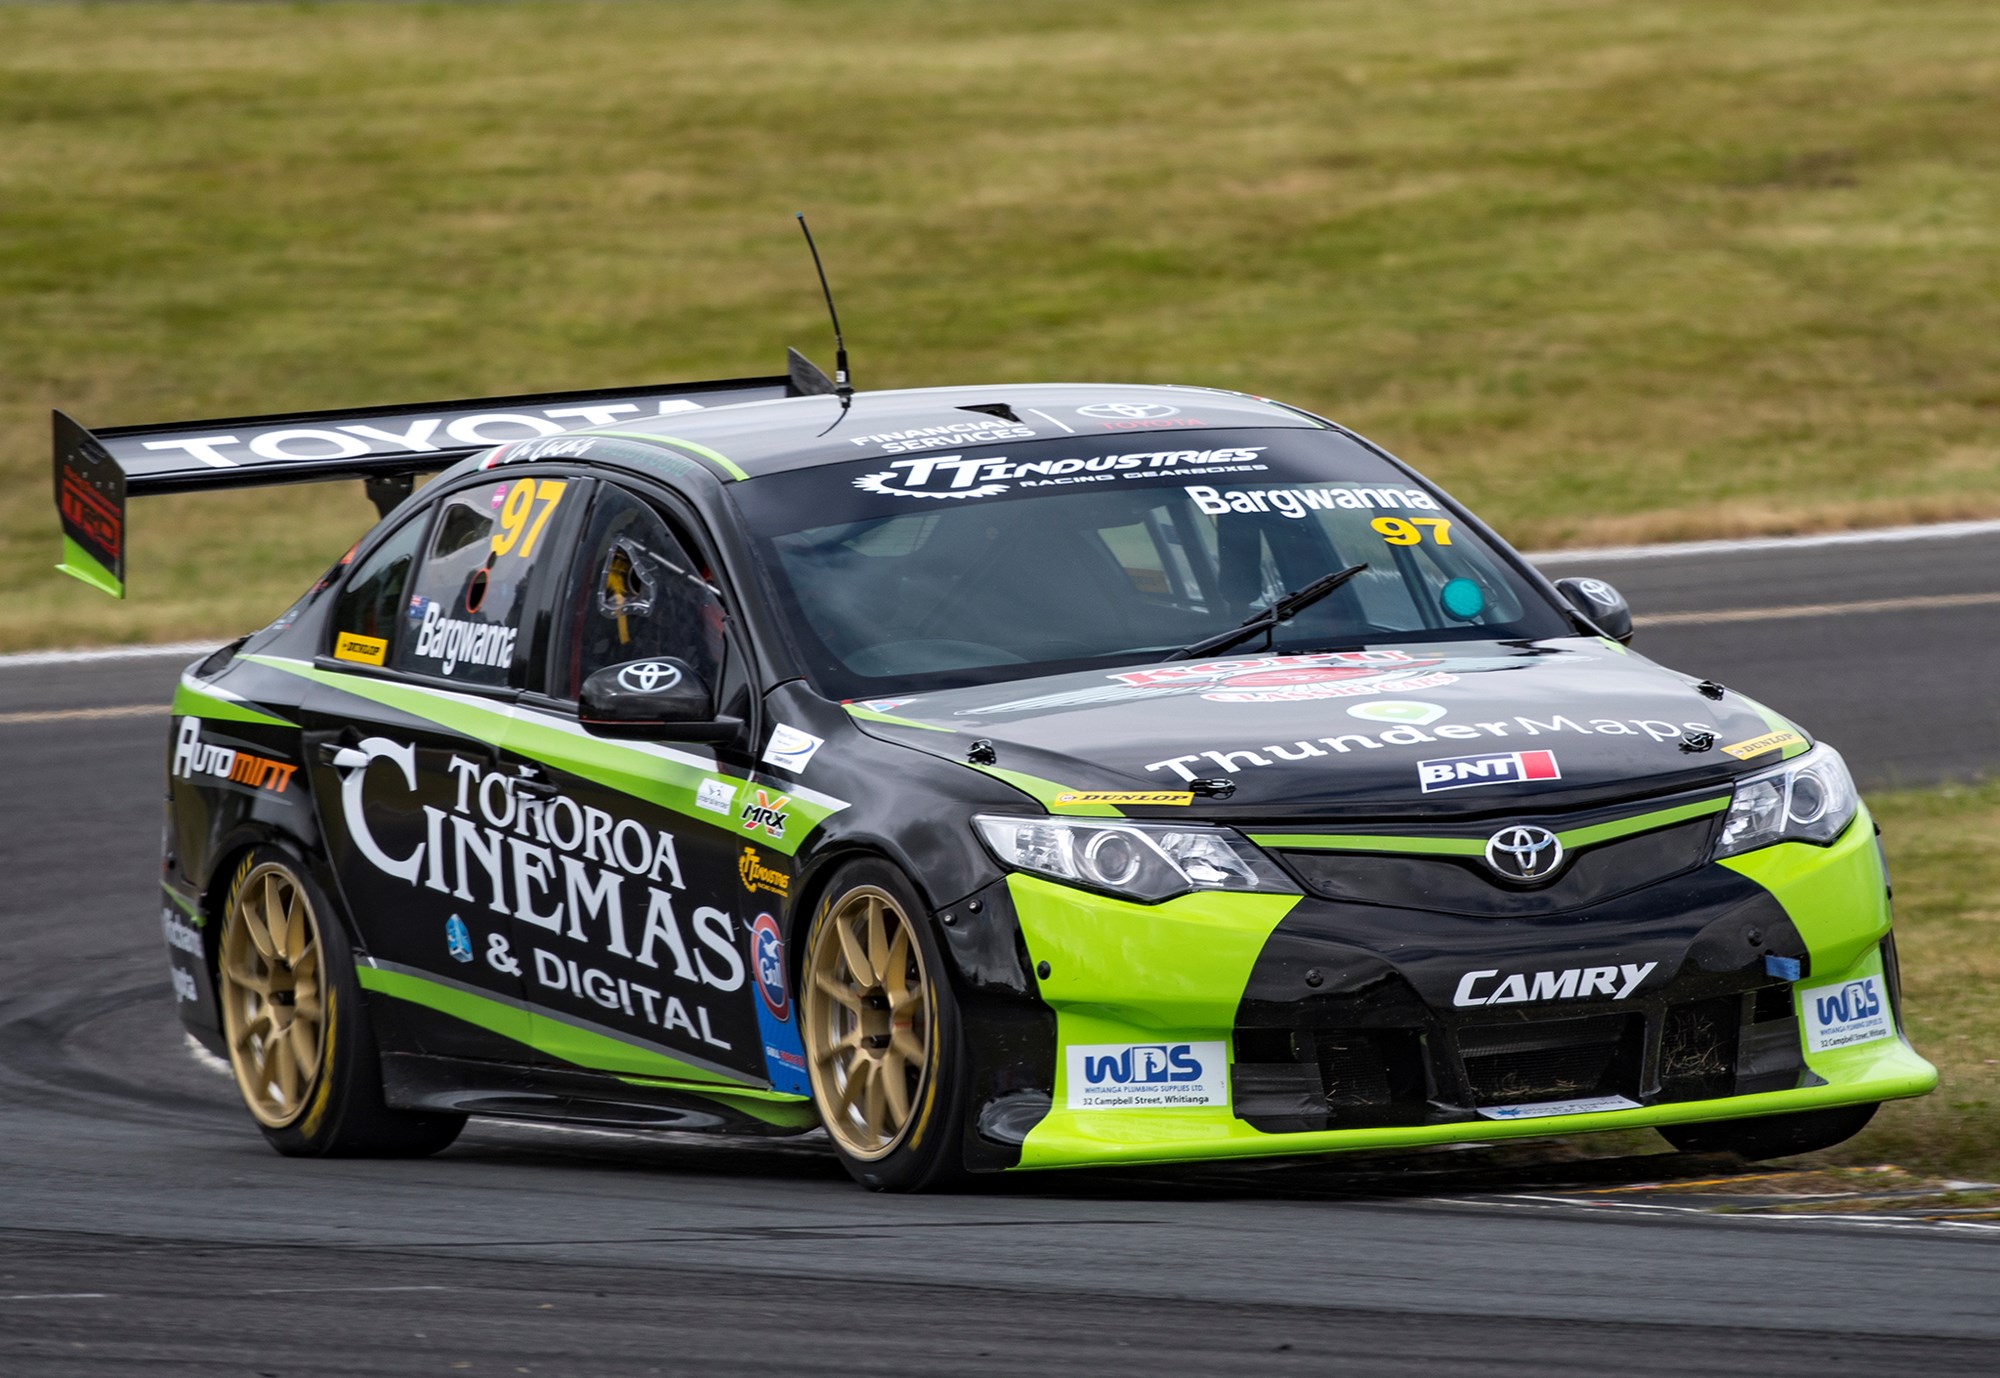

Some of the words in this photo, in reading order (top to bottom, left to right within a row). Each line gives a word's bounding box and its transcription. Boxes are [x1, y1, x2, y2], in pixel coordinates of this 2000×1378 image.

[850, 419, 1024, 447] FINANCIAL
[1099, 416, 1207, 432] TOYOTA
[881, 427, 1036, 453] SERVICES
[1019, 474, 1115, 488] RACING
[1123, 464, 1269, 479] GEARBOXES
[1184, 486, 1440, 519] Bargwanna
[491, 477, 568, 559] 97
[1370, 516, 1453, 546] 97
[414, 602, 518, 676] Bargwanna
[1203, 685, 1377, 702] CLASSIC
[1376, 672, 1458, 691] CARS
[1742, 733, 1793, 752] DUNLOP
[1423, 754, 1516, 782] BNT
[1081, 792, 1189, 803] DUNLOP
[448, 753, 686, 890] TOKOROA
[741, 804, 787, 830] MRX
[341, 736, 746, 992] CINEMAS
[759, 957, 784, 988] Gull
[1453, 961, 1659, 1007] CAMRY
[486, 932, 523, 977] &
[532, 947, 732, 1051] DIGITAL
[1815, 979, 1880, 1026] WPS
[1085, 1044, 1203, 1084] WPS
[1084, 1086, 1122, 1094] WHITIANGA
[1123, 1086, 1159, 1094] PLUMBING
[1160, 1085, 1190, 1093] SUPPLIES
[1191, 1084, 1206, 1092] LTD.
[1094, 1097, 1133, 1106] Campbell
[1134, 1096, 1163, 1105] Street,
[1164, 1095, 1209, 1104] Whitianga
